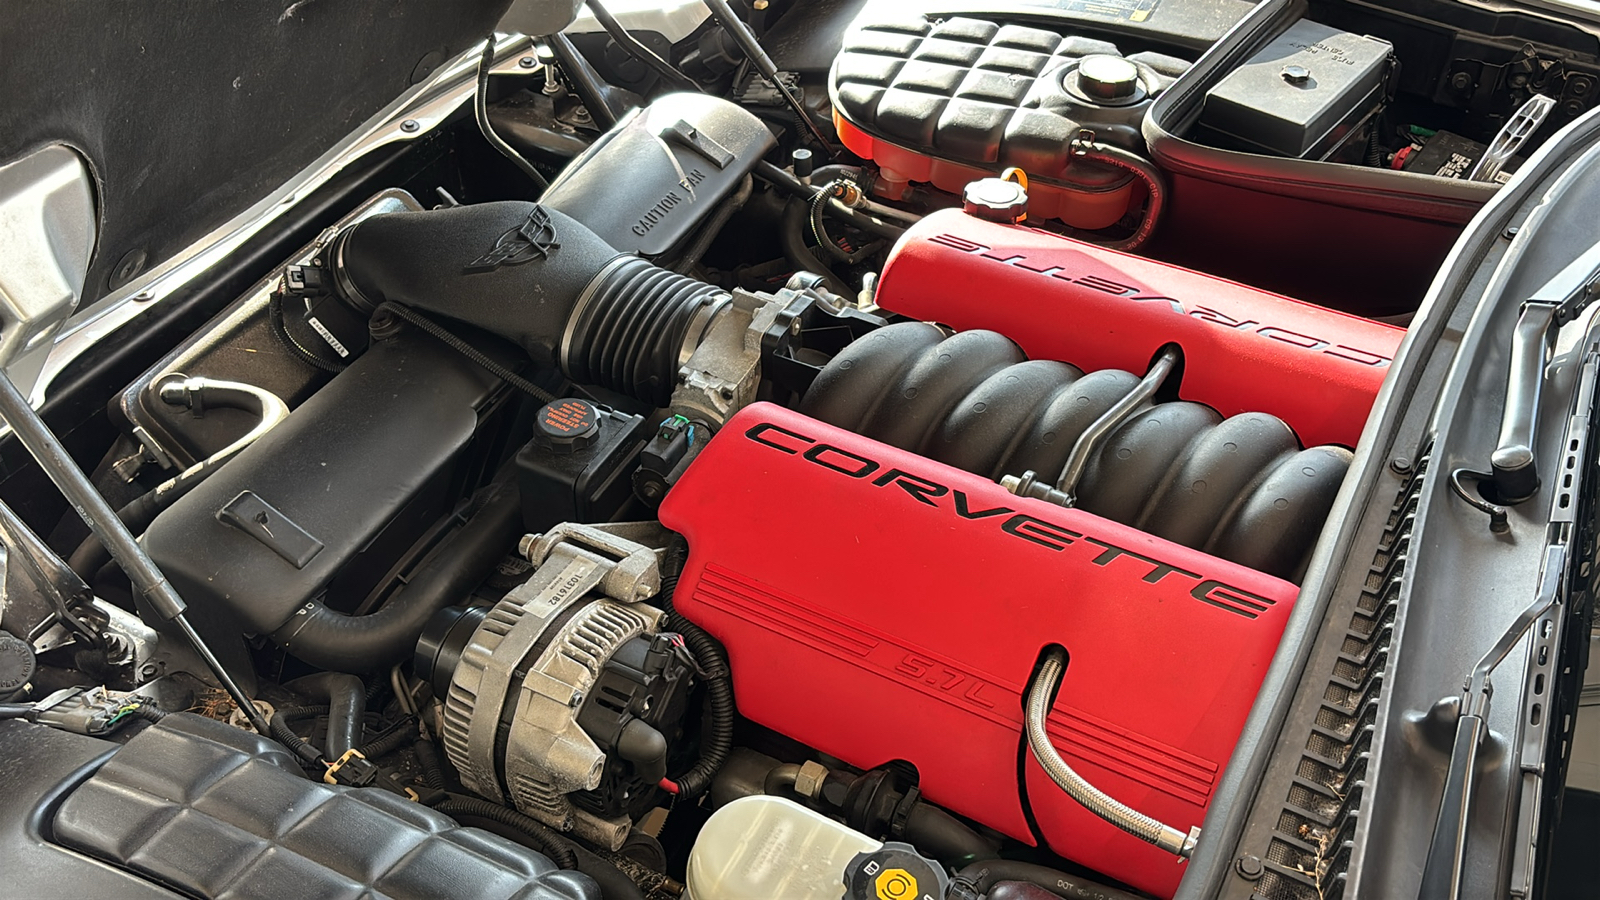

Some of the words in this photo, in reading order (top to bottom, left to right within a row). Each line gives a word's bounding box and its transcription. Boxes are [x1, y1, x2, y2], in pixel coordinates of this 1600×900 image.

[1331, 55, 1355, 65] FUSE
[631, 190, 682, 237] CAUTION
[678, 168, 706, 193] FAN
[928, 233, 1393, 368] CORVETTE
[545, 418, 570, 432] POWER
[547, 412, 580, 429] STEERING
[743, 421, 1278, 621] CORVETTE
[548, 574, 583, 606] 10316182
[894, 653, 995, 709] 5.7L
[1056, 879, 1074, 890] DOT
